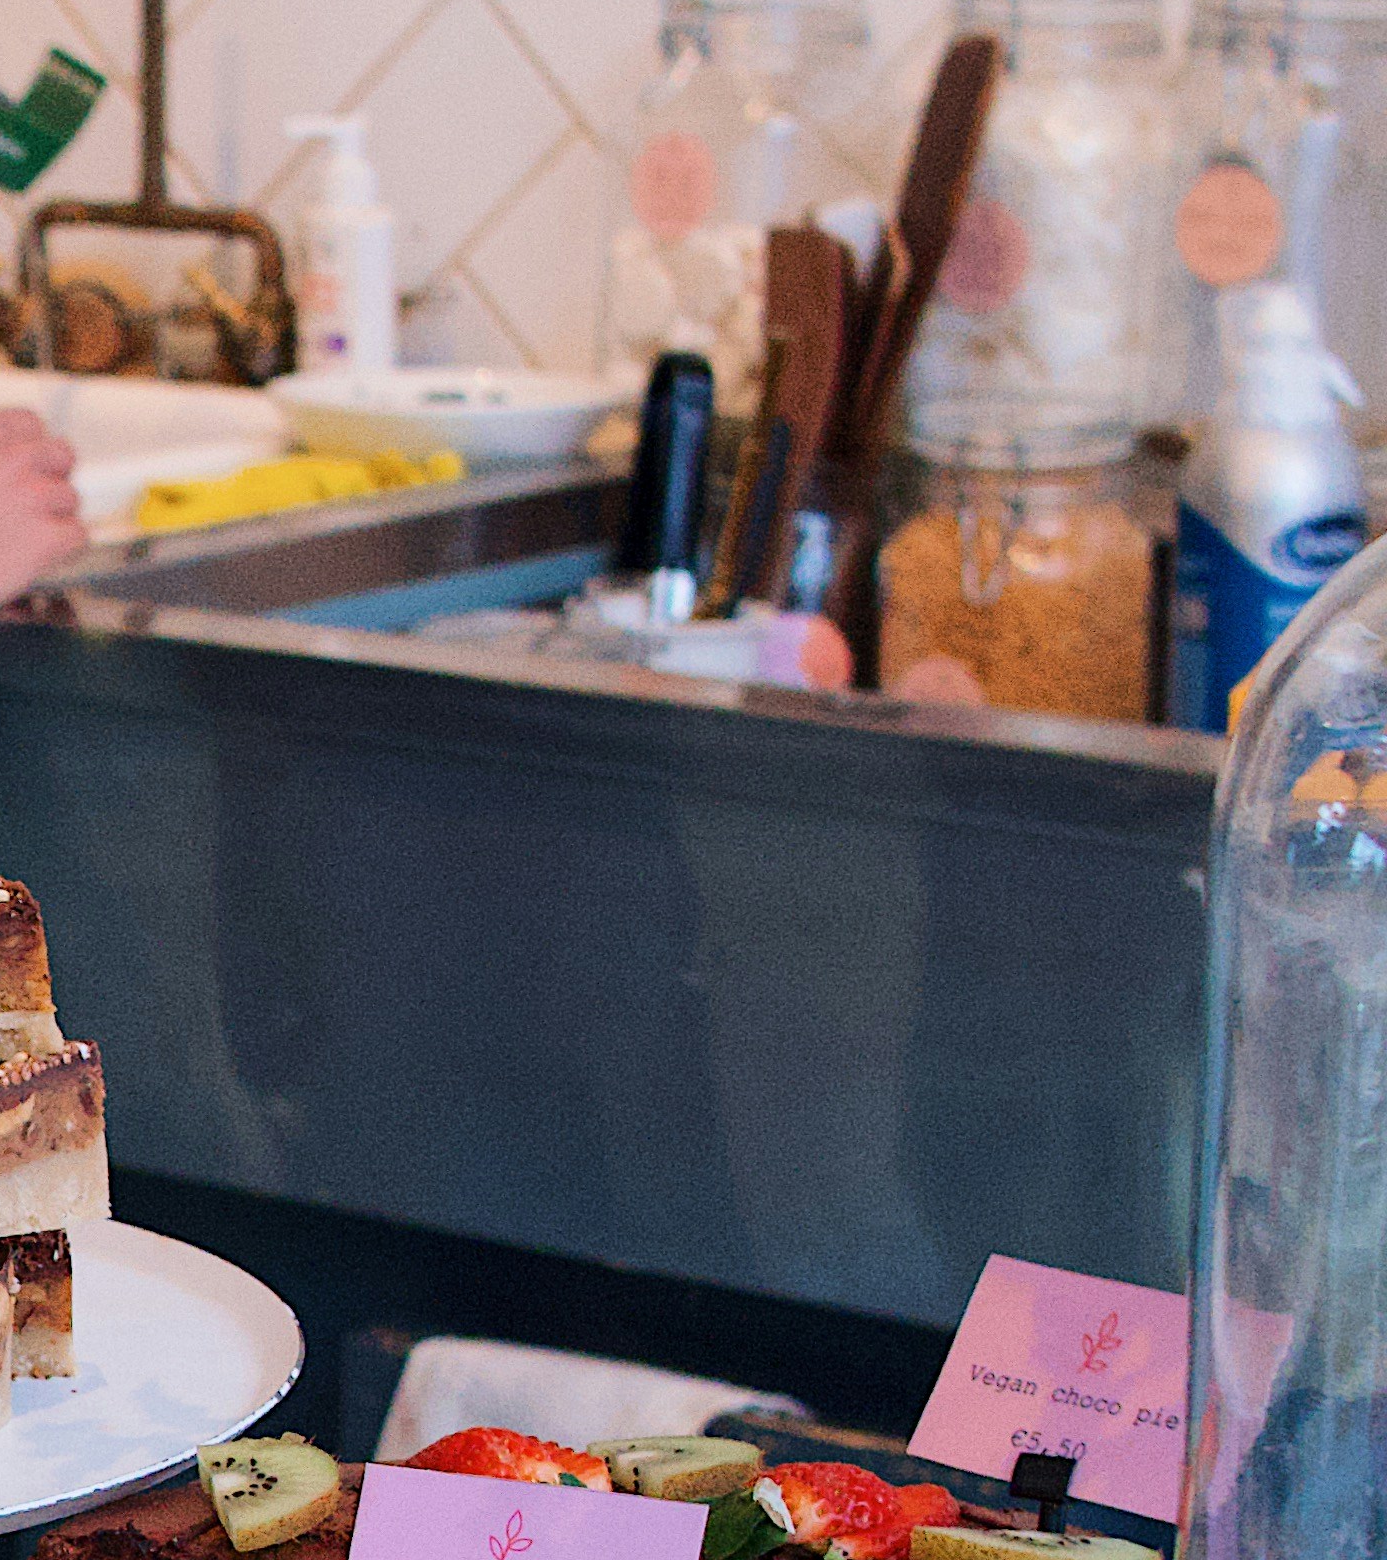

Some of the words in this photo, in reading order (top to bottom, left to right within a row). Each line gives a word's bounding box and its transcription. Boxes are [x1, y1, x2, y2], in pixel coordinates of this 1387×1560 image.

[970, 1364, 1038, 1396] Vegan
[1051, 1385, 1122, 1416] choco
[1133, 1406, 1180, 1430] pie
